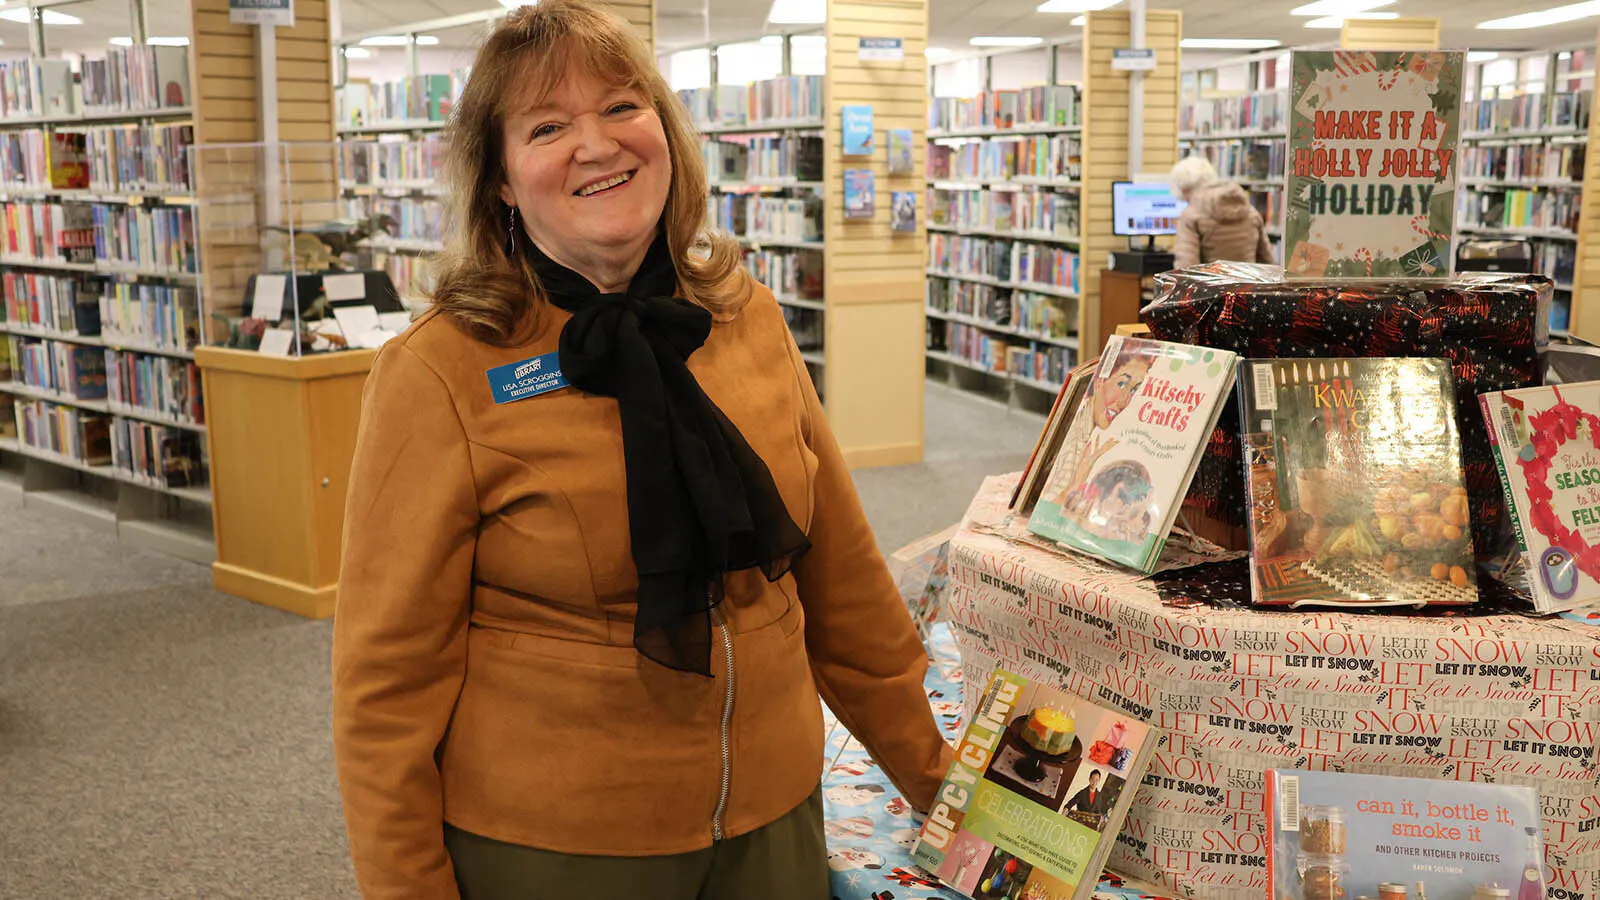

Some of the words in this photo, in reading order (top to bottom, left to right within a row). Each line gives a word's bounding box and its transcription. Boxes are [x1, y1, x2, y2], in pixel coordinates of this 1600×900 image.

[1314, 110, 1382, 140] MAKE
[1389, 111, 1414, 140] IT
[1421, 111, 1437, 140] A
[1293, 149, 1372, 177] HOLLY
[1378, 148, 1454, 178] JOLLY
[1308, 183, 1435, 215] HOLIDAY
[502, 381, 518, 392] LISA
[518, 370, 562, 388] SCROGGINS
[510, 386, 535, 397] EXECUTIVE
[536, 380, 560, 390] DIRECTOR
[1141, 376, 1206, 412] Kitschy
[1138, 401, 1189, 432] Crafts
[1555, 468, 1600, 490] SEASO
[980, 554, 1031, 586] SNOW
[980, 573, 993, 586] LET
[994, 577, 1001, 590] IT
[1002, 580, 1026, 598] SNOW
[1028, 593, 1057, 620] LET
[1059, 583, 1118, 618] SNOW
[1059, 604, 1074, 618] LET
[1074, 608, 1082, 620] IT
[1084, 611, 1114, 632] SNOW
[1118, 616, 1148, 632] SNOW
[1117, 625, 1150, 654] LET
[1152, 615, 1228, 649] SNOW
[1234, 631, 1263, 642] LET
[1265, 632, 1280, 642] IT
[1382, 636, 1412, 649] LET
[1414, 638, 1430, 650] IT
[1153, 638, 1170, 654] LET
[1170, 642, 1181, 657] IT
[1183, 648, 1226, 663] SNOW
[1234, 641, 1278, 652] SNOW
[1284, 630, 1376, 657] SNOW
[1382, 648, 1428, 660] SNOW
[1435, 637, 1530, 664] SNOW
[1536, 643, 1566, 656] LET
[1570, 645, 1586, 656] IT
[1023, 648, 1038, 660] LET
[1038, 652, 1046, 664] IT
[1046, 655, 1072, 677] SNOW
[1124, 650, 1147, 674] IT
[1232, 652, 1282, 678] LET
[1286, 655, 1310, 668] LET
[1312, 656, 1326, 668] IT
[1328, 658, 1376, 672] SNOW
[1436, 663, 1460, 676] LET
[1462, 664, 1476, 676] IT
[1478, 664, 1528, 678] SNOW
[1536, 655, 1584, 666] SNOW
[1276, 672, 1300, 691] Let
[1305, 677, 1320, 691] it
[1325, 674, 1383, 695] Snow
[1380, 661, 1432, 686] LET
[1532, 668, 1588, 692] LET
[1068, 671, 1101, 701] LET
[1102, 664, 1157, 706] SNOW
[1240, 678, 1268, 698] IT
[1425, 679, 1451, 699] Let
[1455, 683, 1472, 698] it
[1476, 680, 1534, 700] Snow
[1098, 685, 1114, 700] LET
[1112, 690, 1122, 705] IT
[1120, 696, 1154, 720] SNOW
[1160, 692, 1188, 702] LET
[1190, 695, 1204, 704] IT
[1160, 702, 1202, 712] SNOW
[1387, 688, 1417, 710] IT
[1540, 694, 1572, 718] IT
[1209, 695, 1297, 724] SNOW
[1301, 707, 1330, 719] LET
[1332, 710, 1348, 721] IT
[1160, 711, 1208, 734] LET
[1209, 715, 1232, 728] LET
[1234, 719, 1246, 731] IT
[1248, 722, 1294, 736] SNOW
[1301, 717, 1346, 730] SNOW
[1353, 710, 1446, 736] SNOW
[1450, 717, 1480, 728] LET
[1484, 719, 1500, 730] IT
[1450, 728, 1498, 738] SNOW
[1505, 718, 1600, 744] SNOW
[1168, 732, 1194, 755] IT
[1229, 736, 1243, 750] it
[1248, 738, 1302, 758] Snow
[1300, 728, 1350, 753] LET
[1352, 732, 1376, 745] LET
[1378, 734, 1392, 746] IT
[1395, 734, 1442, 748] SNOW
[1448, 738, 1502, 760] LET
[1504, 740, 1528, 752] LET
[1532, 742, 1546, 755] IT
[1548, 744, 1594, 759] SNOW
[922, 680, 1019, 849] UPCYCLING
[1307, 752, 1336, 772] IT
[1374, 752, 1388, 764] it
[1392, 750, 1450, 766] Snow
[1454, 760, 1486, 782] IT
[1163, 778, 1176, 790] IT
[1178, 780, 1220, 798] SNOW
[978, 789, 1088, 857] CELEBRATIONS
[1232, 812, 1260, 832] IT
[1356, 799, 1396, 814] can
[1402, 798, 1419, 819] it,
[1427, 800, 1489, 822] bottle
[1496, 806, 1516, 826] it,
[1153, 825, 1178, 837] LET
[1180, 829, 1196, 840] IT
[1153, 836, 1194, 850] SNOW
[1391, 822, 1461, 841] smoke
[1468, 824, 1482, 842] it
[1153, 846, 1199, 870] LET
[1376, 844, 1392, 854] AND
[1394, 846, 1420, 857] OTHER
[1422, 848, 1457, 860] KITCHEN
[1460, 851, 1501, 863] PROJECTS
